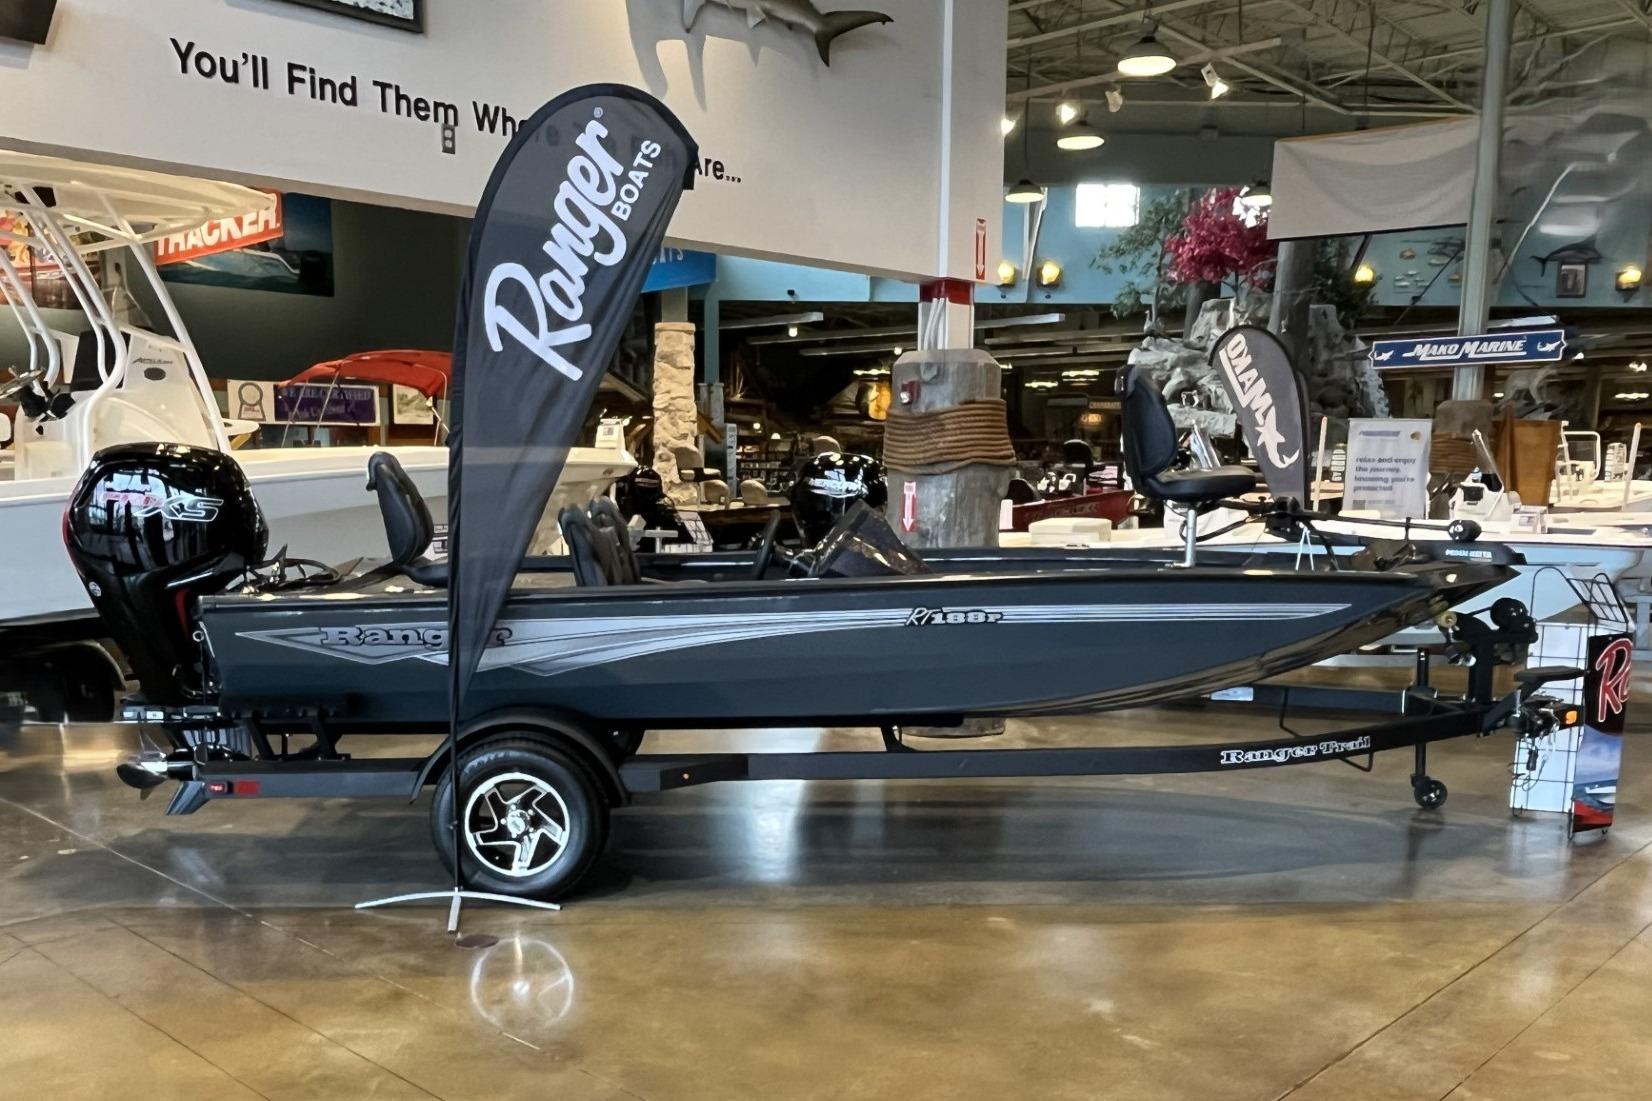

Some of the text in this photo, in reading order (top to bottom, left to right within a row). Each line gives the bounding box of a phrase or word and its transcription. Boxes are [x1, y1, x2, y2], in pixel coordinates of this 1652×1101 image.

[170, 37, 268, 90] You'll
[287, 62, 358, 107] Find
[372, 80, 459, 127] Them
[611, 140, 662, 221] BOATS
[484, 119, 624, 381] Ranger
[1403, 339, 1526, 361] MAKO MARINE
[320, 626, 513, 651] Rangr
[1220, 735, 1371, 765] Ranger Trail
